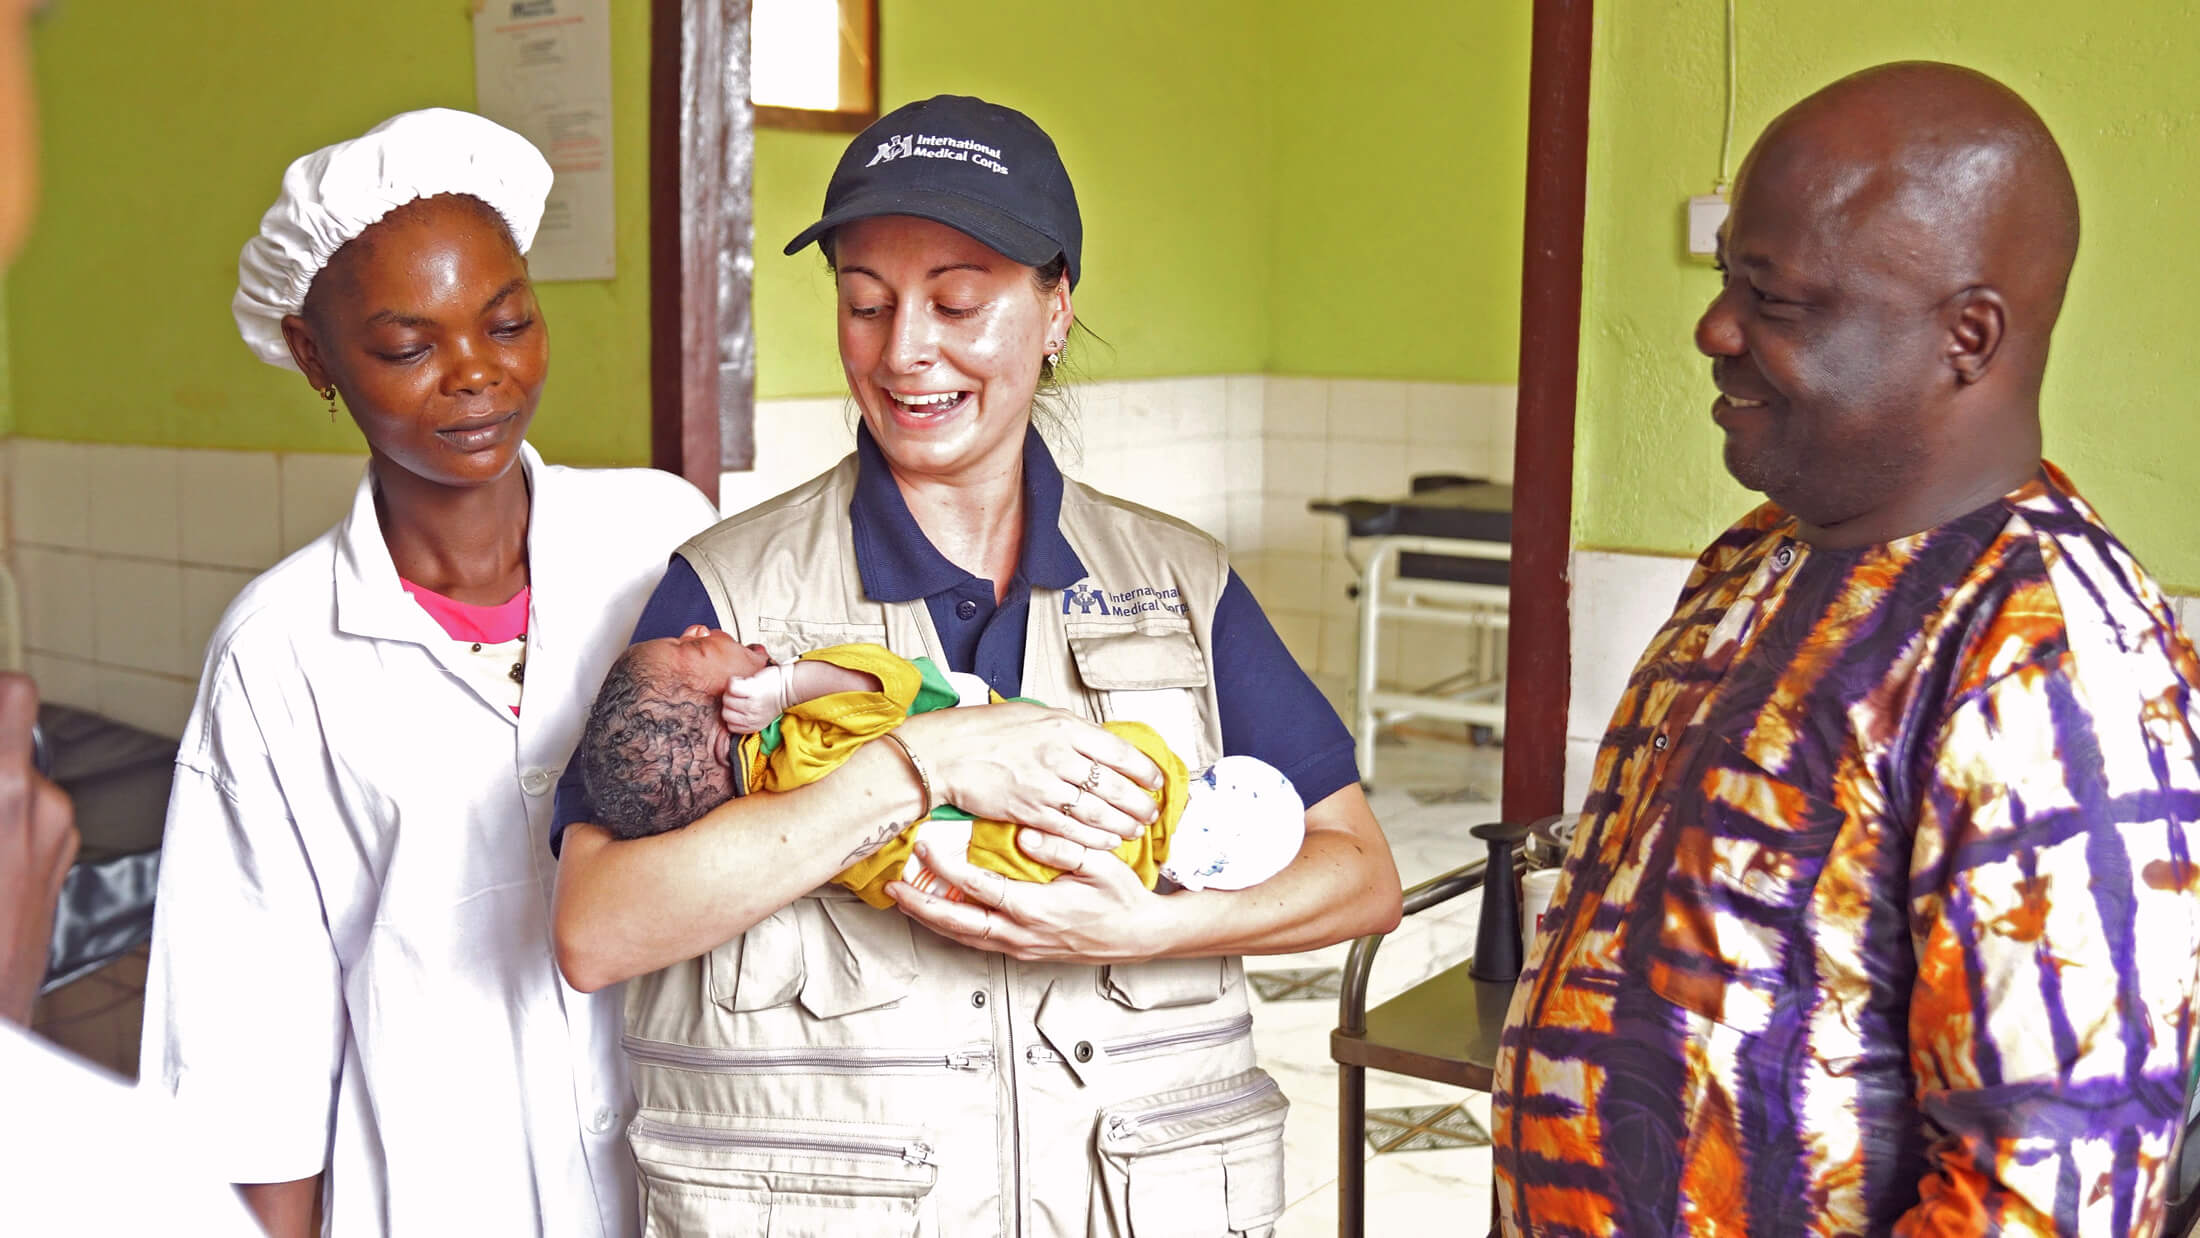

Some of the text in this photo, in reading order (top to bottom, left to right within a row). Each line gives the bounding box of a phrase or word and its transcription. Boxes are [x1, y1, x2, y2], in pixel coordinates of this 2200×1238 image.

[918, 135, 1000, 159] International
[914, 147, 1008, 175] Medical Corps
[1112, 599, 1159, 617] Medical
